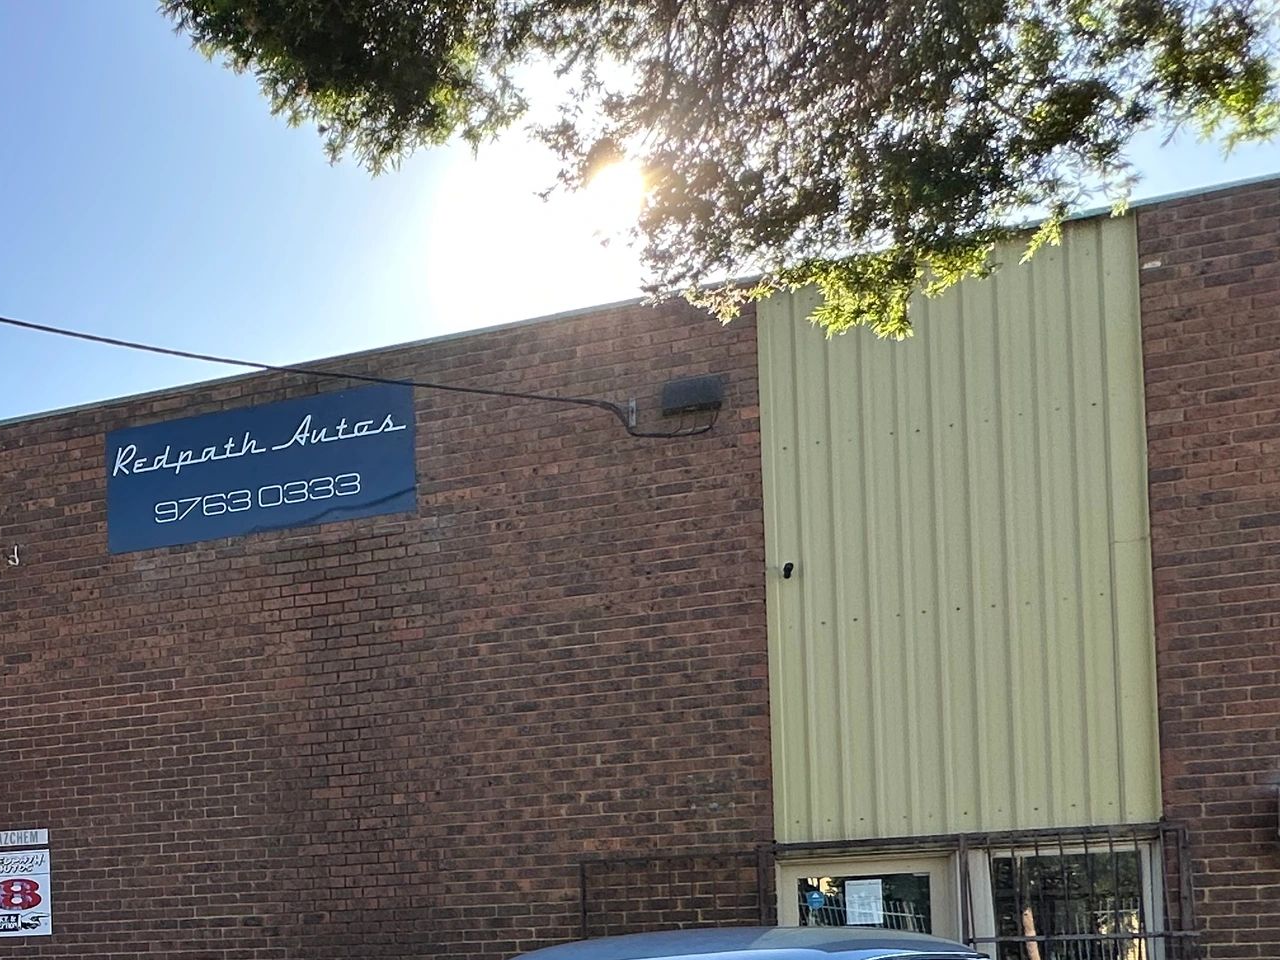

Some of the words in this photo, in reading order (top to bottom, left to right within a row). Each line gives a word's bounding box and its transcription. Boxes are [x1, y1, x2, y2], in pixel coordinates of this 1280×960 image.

[112, 431, 266, 477] Redpath
[272, 414, 407, 450] Autos
[154, 489, 252, 524] 9763
[258, 472, 361, 508] 0333
